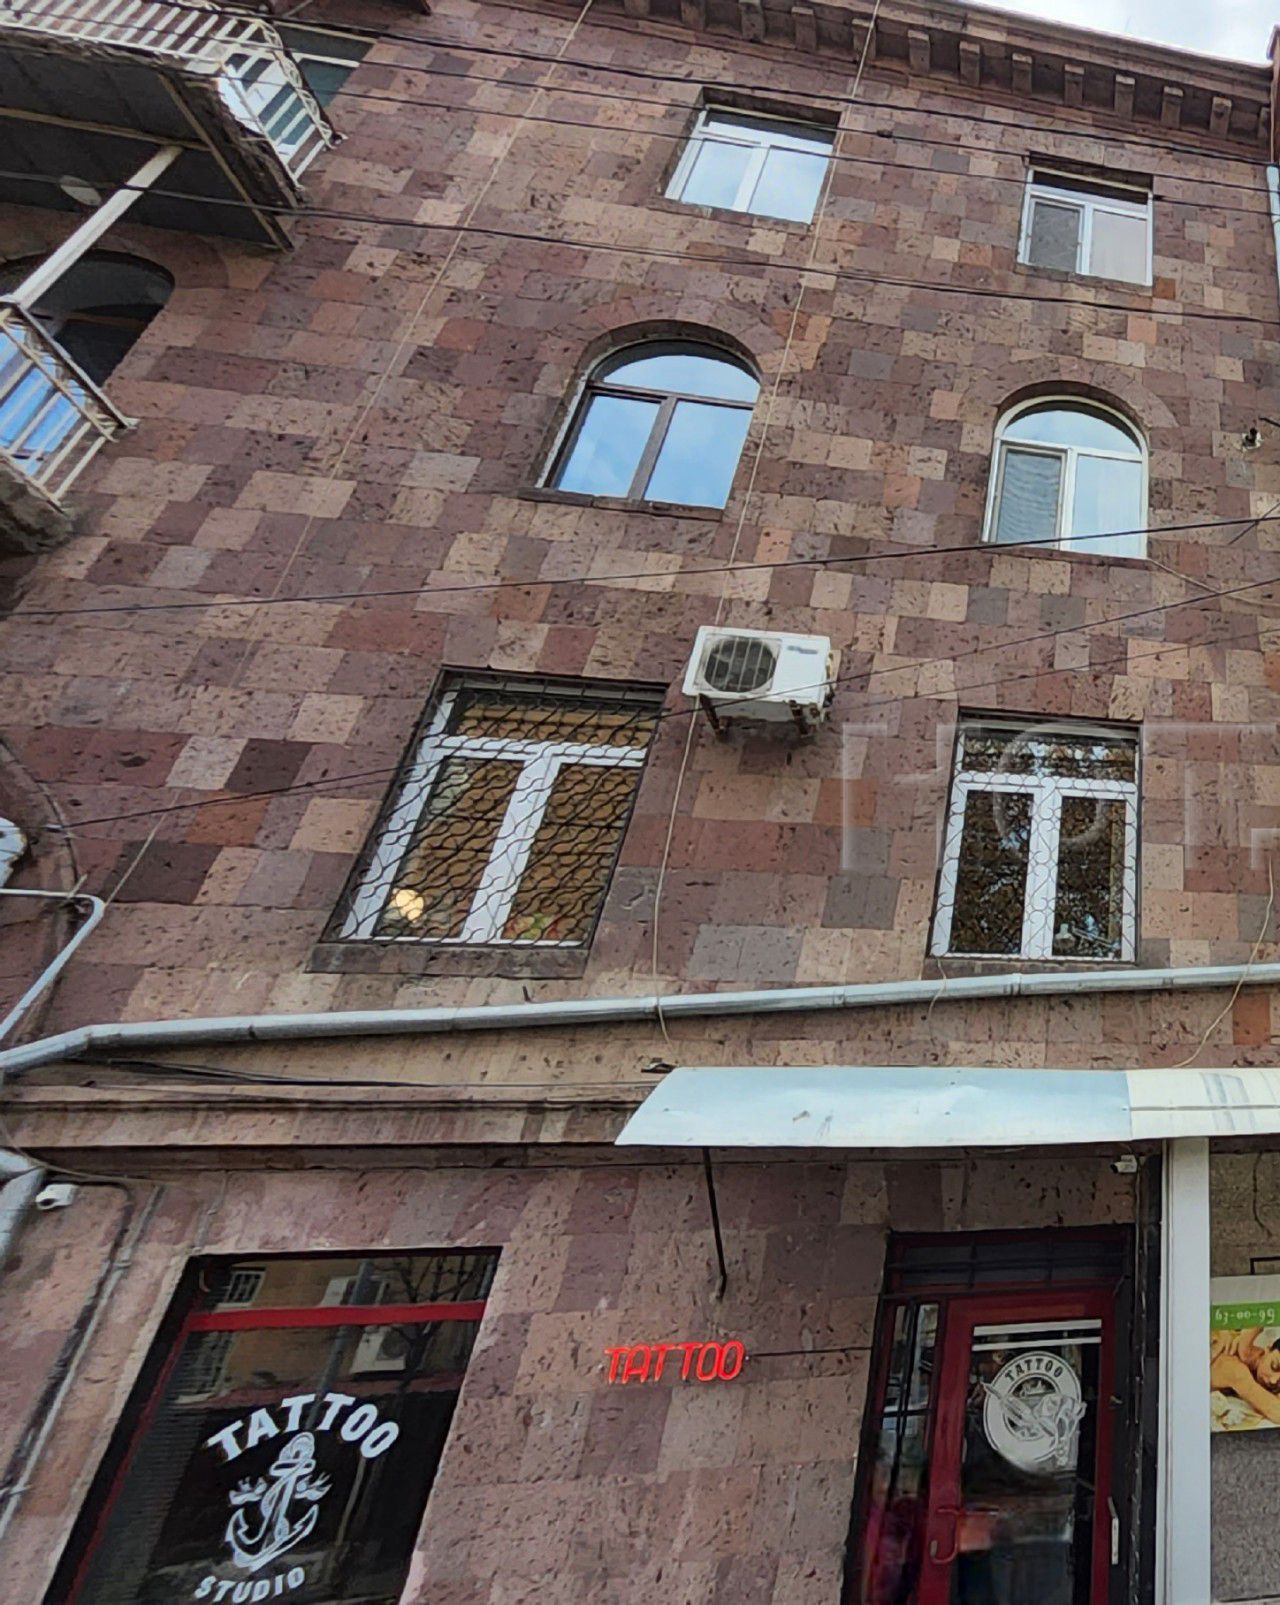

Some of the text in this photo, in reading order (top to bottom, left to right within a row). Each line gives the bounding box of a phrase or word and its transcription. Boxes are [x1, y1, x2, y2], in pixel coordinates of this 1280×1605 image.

[604, 1339, 746, 1384] TATTOO
[1004, 1357, 1064, 1382] TATTOO
[207, 1392, 400, 1463] TATTOO
[194, 1566, 305, 1604] STUDIO
